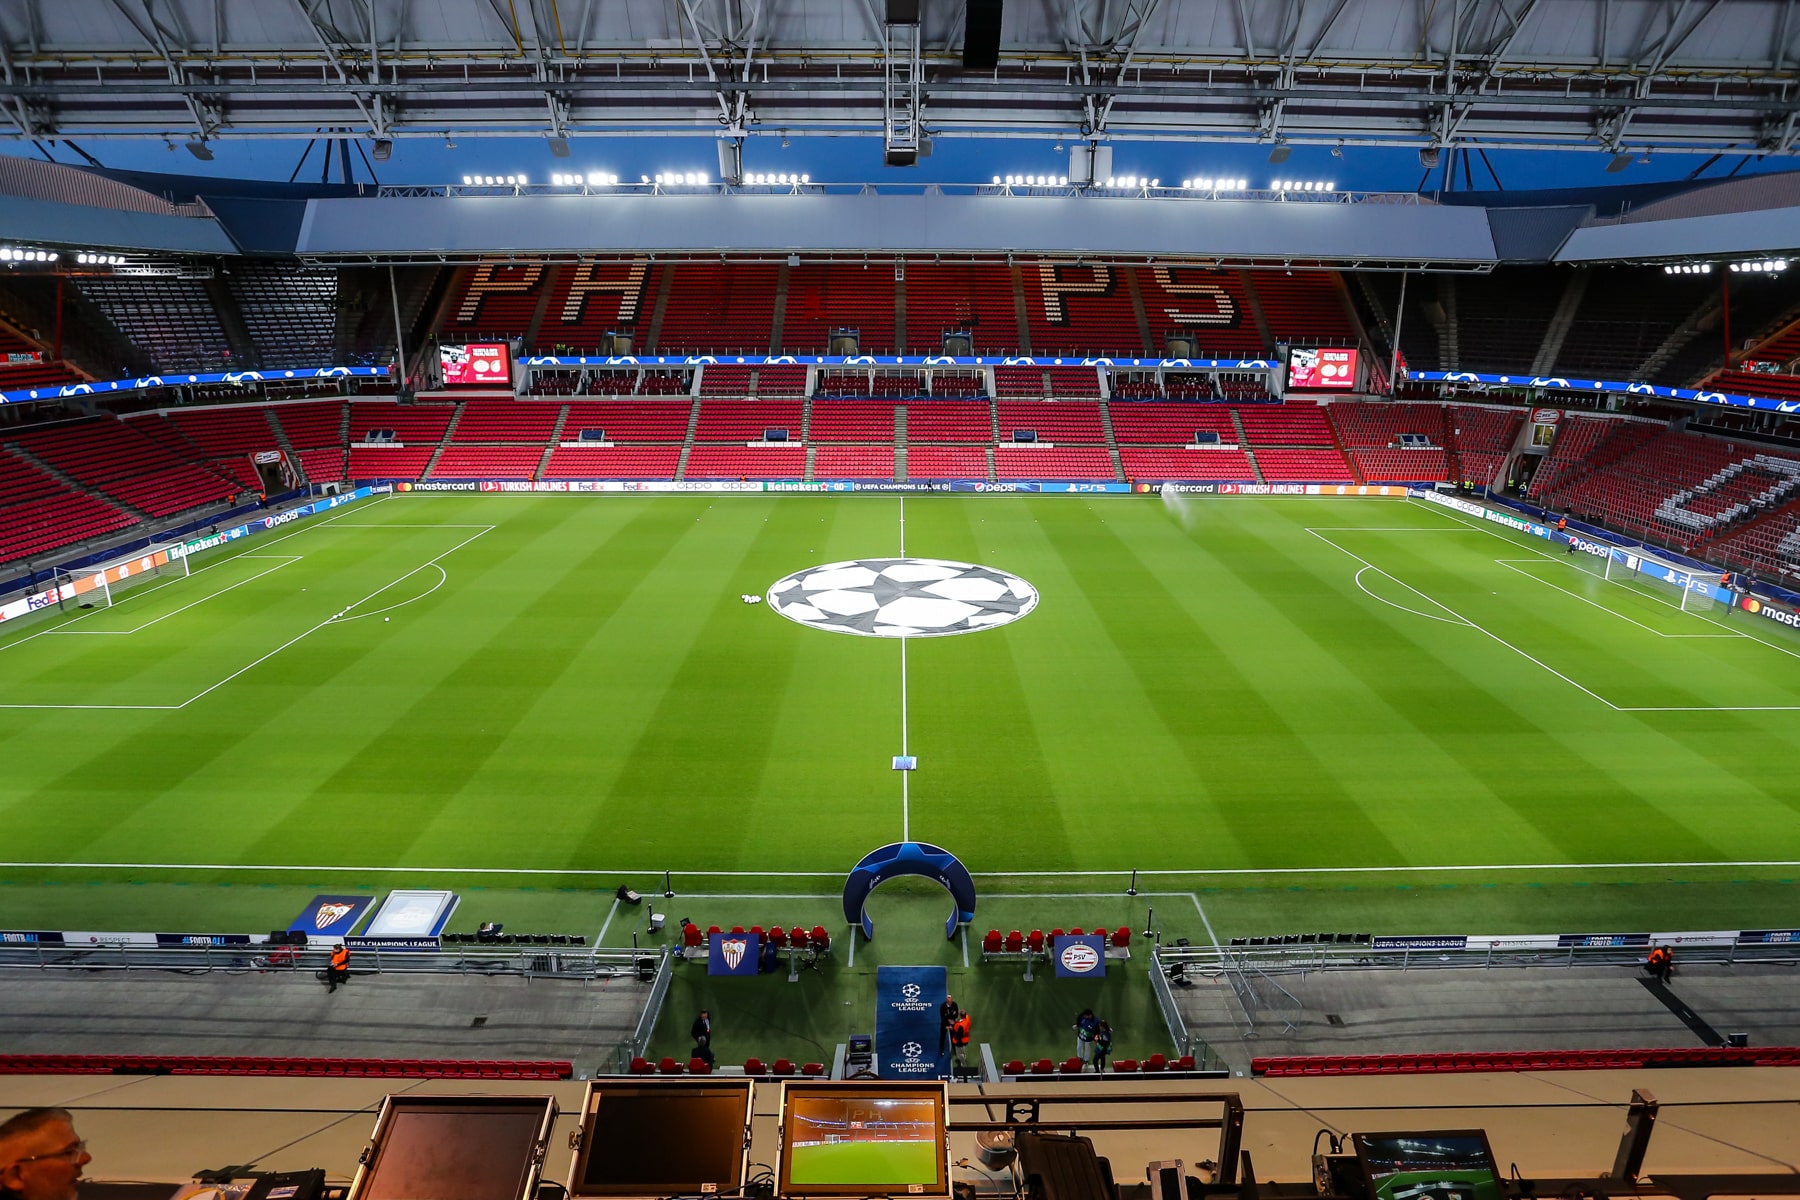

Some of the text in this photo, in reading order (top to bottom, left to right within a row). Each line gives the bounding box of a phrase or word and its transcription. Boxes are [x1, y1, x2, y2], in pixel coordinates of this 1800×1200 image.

[415, 482, 475, 491] mastercard
[500, 482, 568, 491] TURKISH AIRLINES
[578, 482, 605, 491] FedEx
[622, 482, 649, 491] FedEx
[767, 481, 820, 491] Heineken
[986, 482, 1016, 492] pepsi
[1079, 484, 1107, 492] PS5
[1238, 484, 1304, 494] TURKISH AIRLINES
[338, 492, 356, 503] PS5
[274, 510, 299, 527] pepsi
[1485, 509, 1524, 530] Heineken
[171, 537, 220, 560] Heineken
[1578, 540, 1609, 559] pepsi
[1677, 575, 1709, 594] PS5
[26, 589, 65, 611] FedEx
